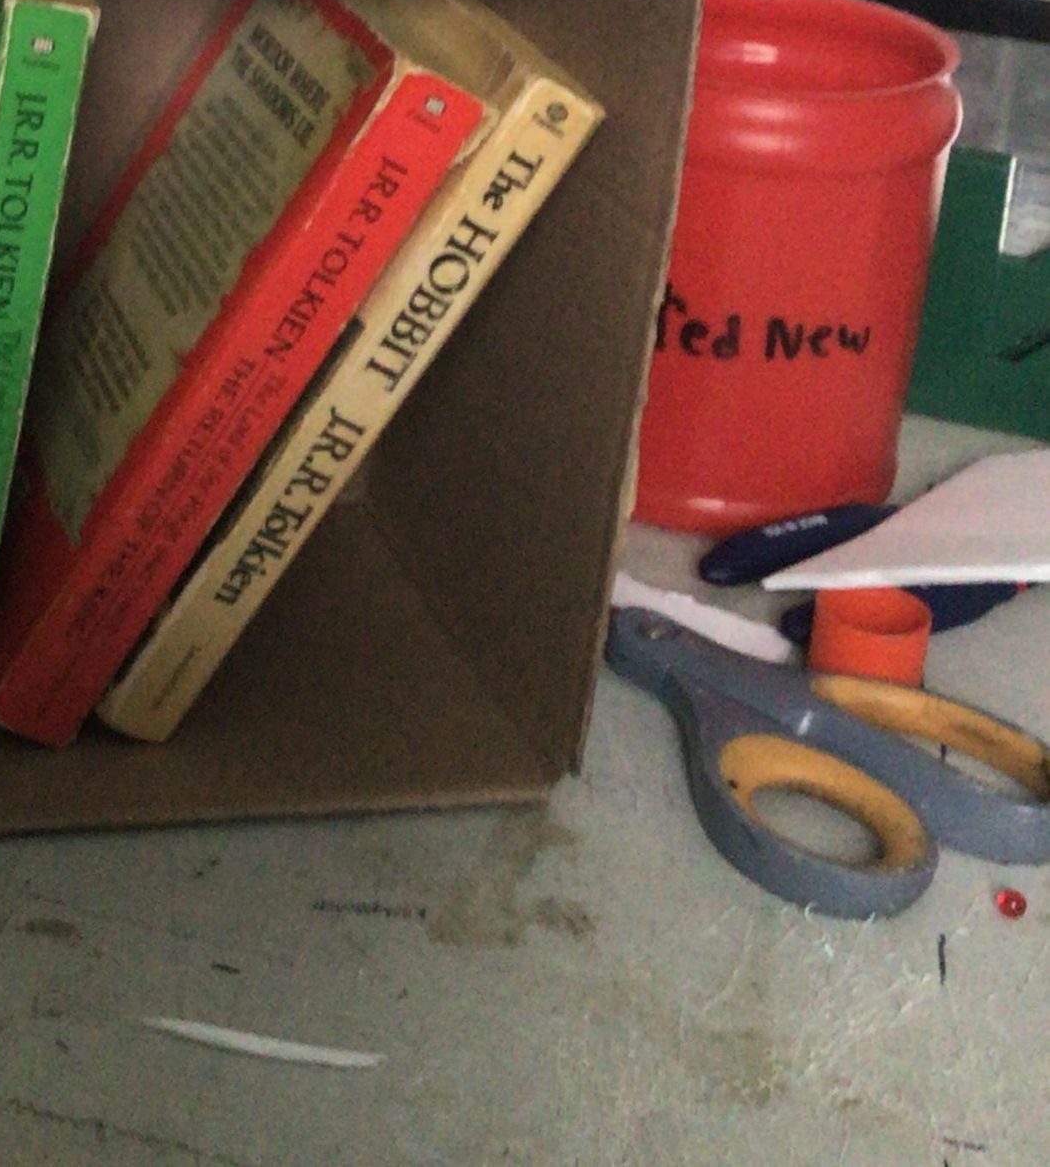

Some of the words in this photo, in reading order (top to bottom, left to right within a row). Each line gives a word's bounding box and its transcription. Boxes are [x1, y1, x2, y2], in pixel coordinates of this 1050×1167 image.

[481, 146, 546, 213] The
[263, 230, 366, 365] TOLKIEN
[365, 210, 499, 392] HOBBIT
[764, 317, 870, 363] New
[216, 357, 257, 404] THE
